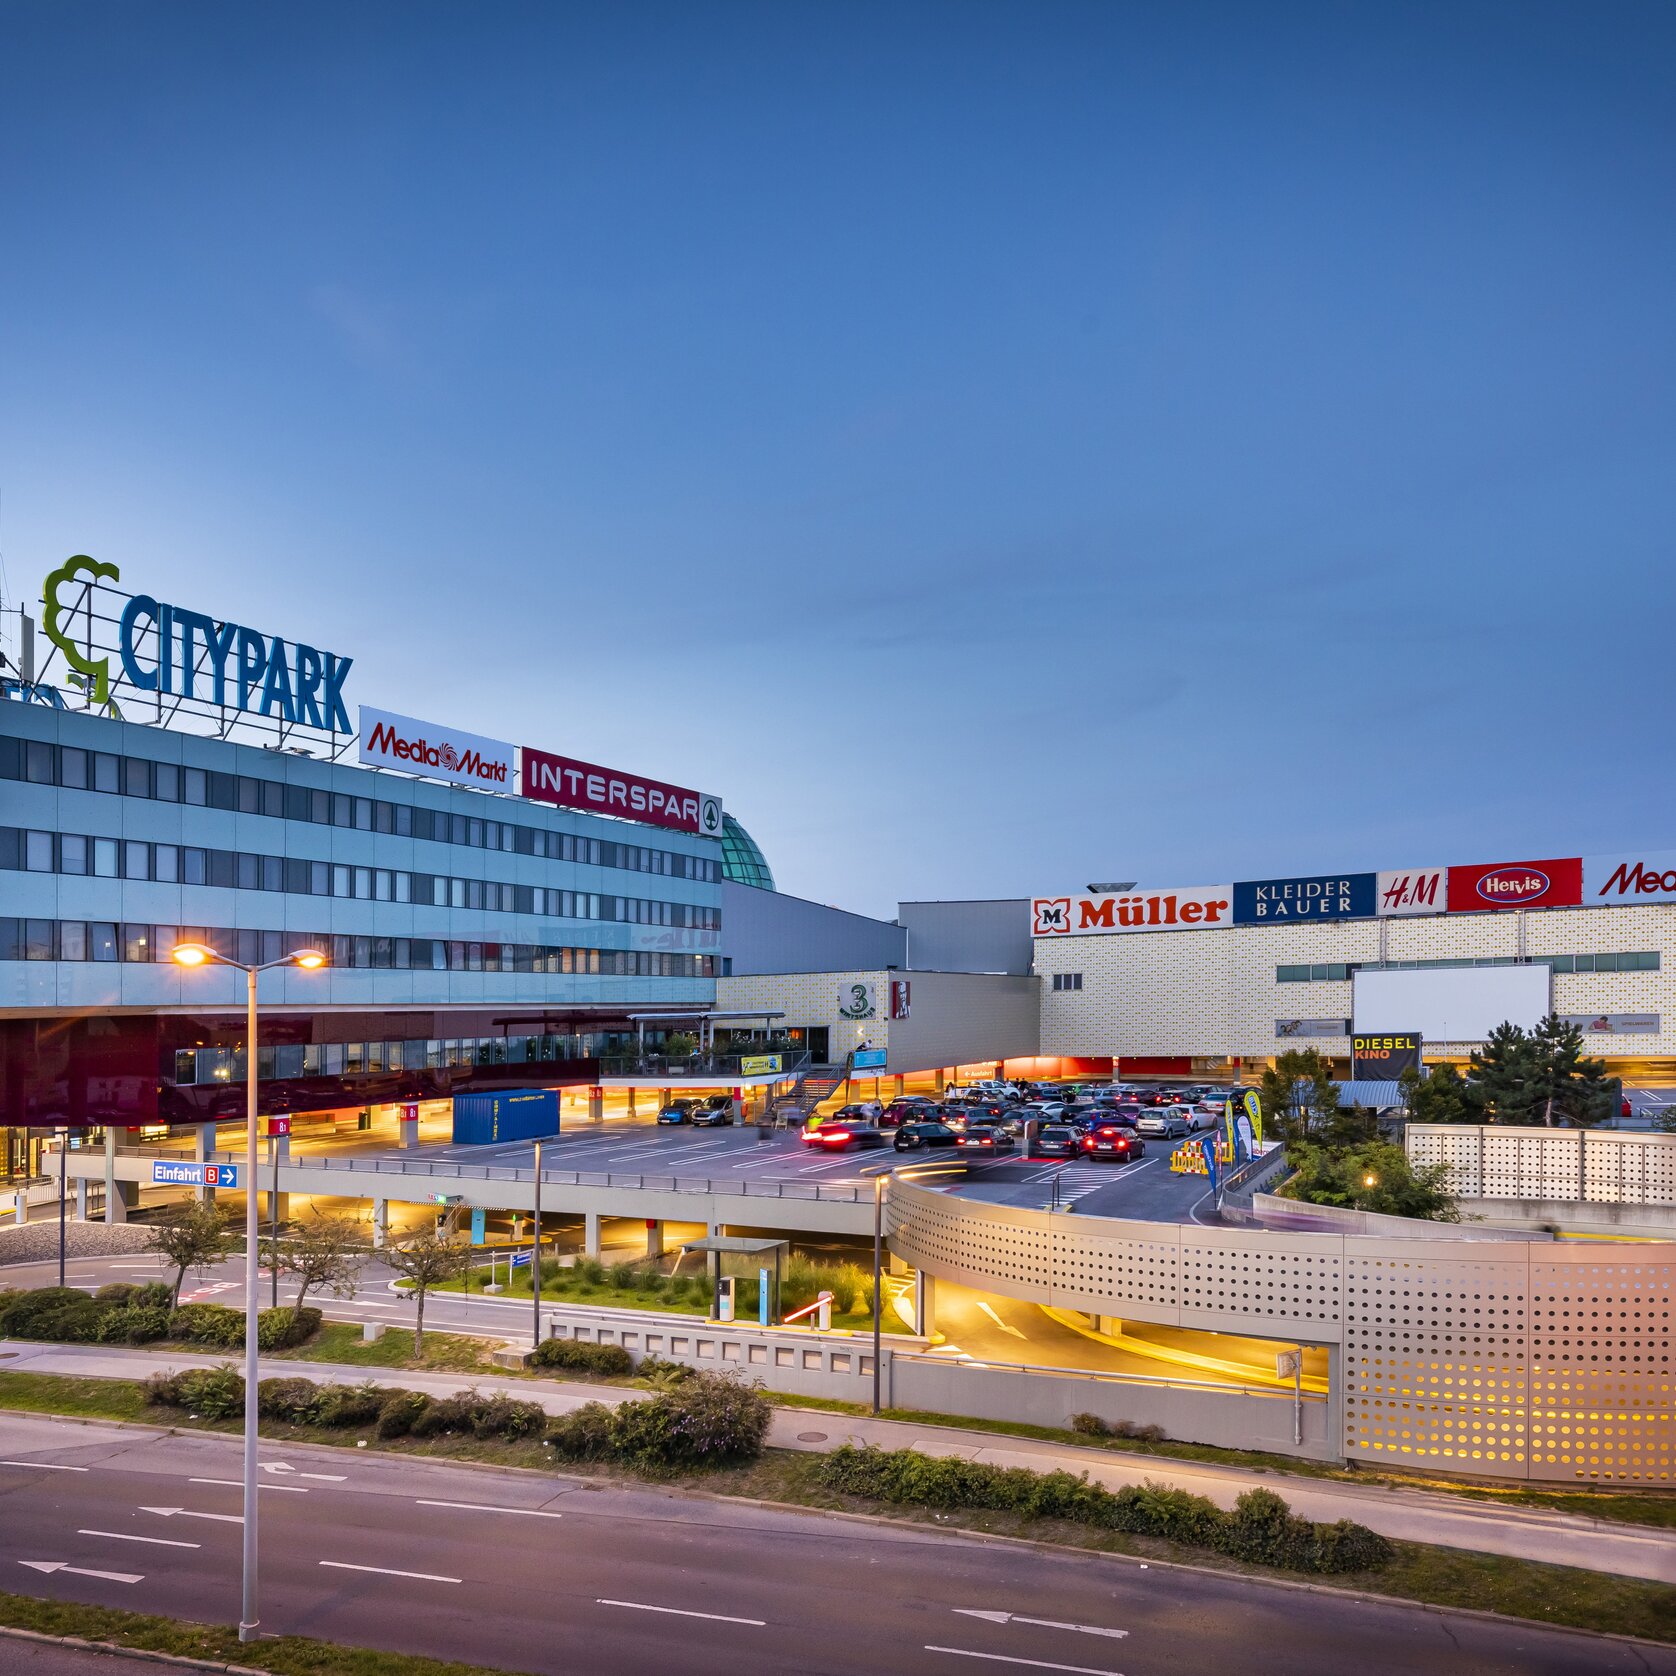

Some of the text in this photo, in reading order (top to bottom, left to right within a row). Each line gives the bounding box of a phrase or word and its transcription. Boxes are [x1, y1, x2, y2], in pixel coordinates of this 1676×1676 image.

[119, 594, 354, 735] CITYPARK
[367, 722, 507, 782] Media Markt
[531, 760, 699, 823] INTERSPAR
[1256, 881, 1351, 900] KLEIDER
[1382, 873, 1440, 909] H&M
[1486, 876, 1542, 894] Hervis
[1078, 895, 1229, 929] Müller
[1256, 898, 1352, 916] BAUER
[850, 984, 869, 1014] 3
[1354, 1038, 1416, 1049] DIESEL
[1354, 1050, 1391, 1060] KINO
[279, 1121, 287, 1132] 8.1
[154, 1165, 216, 1182] Einfahrt B
